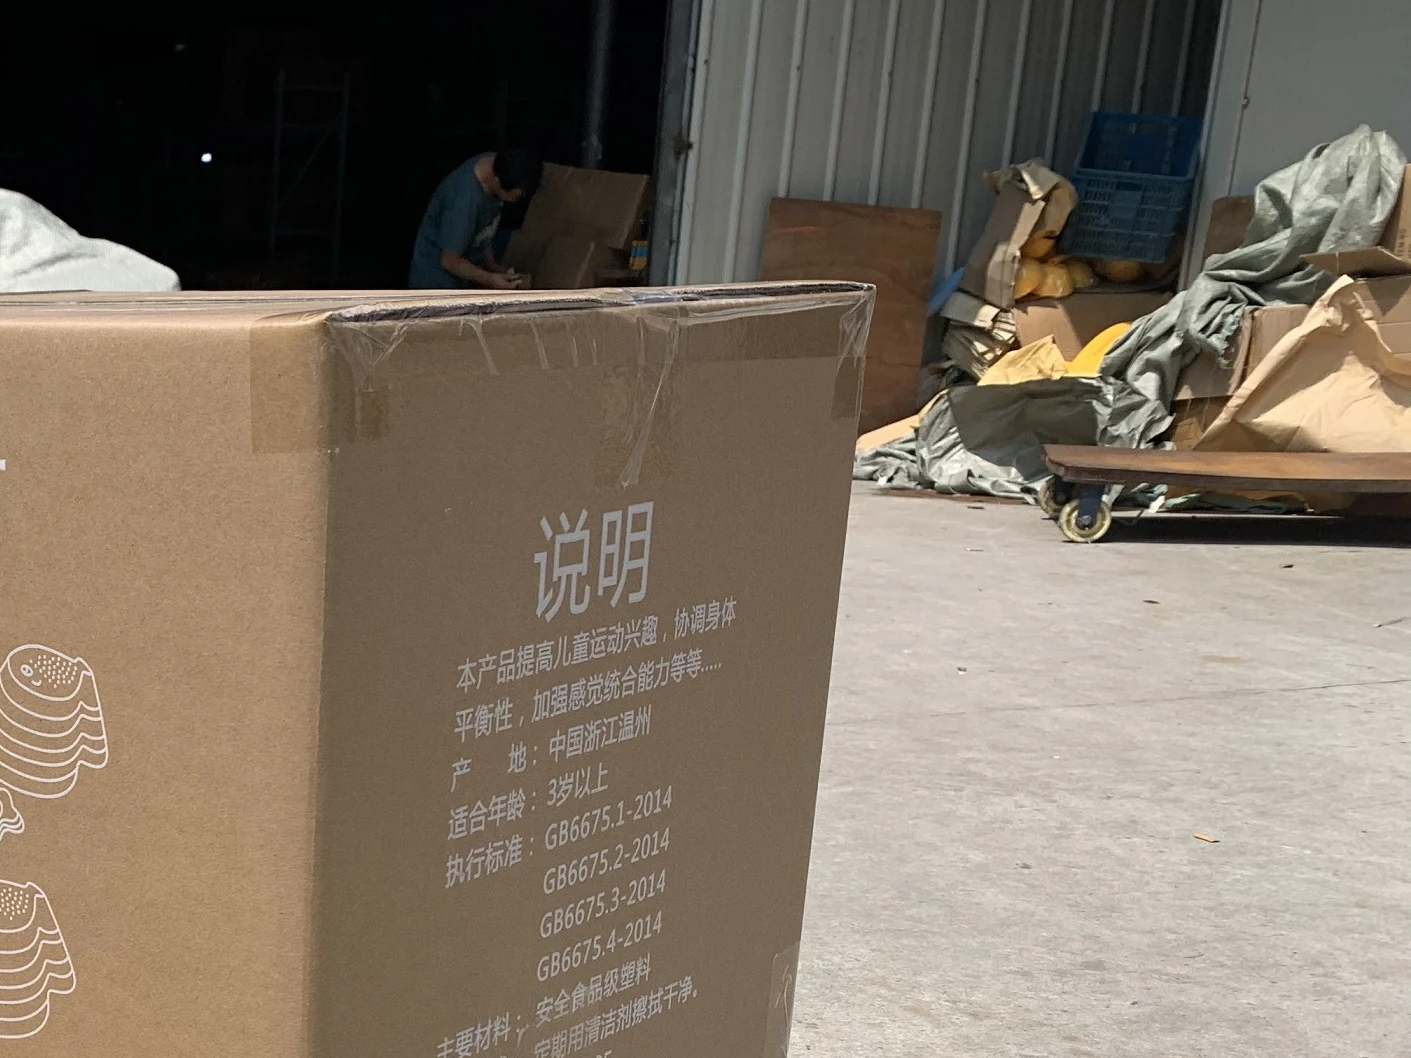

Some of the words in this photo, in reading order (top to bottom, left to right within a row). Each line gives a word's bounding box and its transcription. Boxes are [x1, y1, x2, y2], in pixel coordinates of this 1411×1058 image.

[533, 501, 655, 623] 说明
[543, 828, 671, 895] GB6675.2-2014
[539, 869, 667, 938] GB6675.3-2014
[537, 911, 663, 982] GB6675.4-2014
